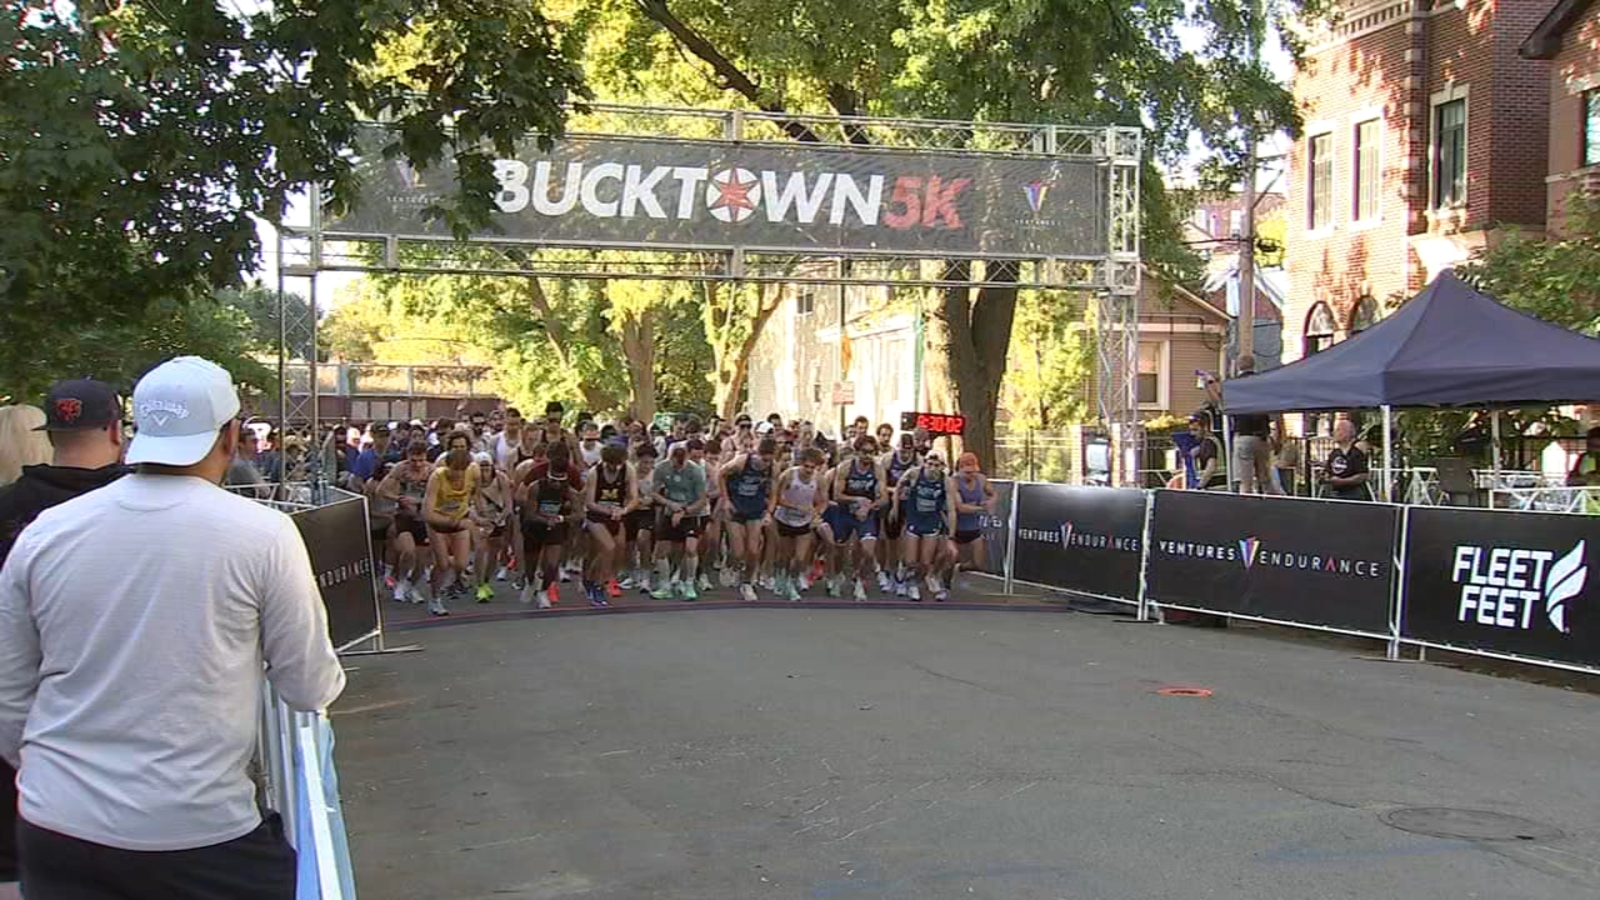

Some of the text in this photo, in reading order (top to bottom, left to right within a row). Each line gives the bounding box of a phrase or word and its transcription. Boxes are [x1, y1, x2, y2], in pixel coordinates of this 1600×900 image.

[883, 174, 973, 231] 5K
[1070, 531, 1140, 552] ENDURANCE
[1159, 540, 1381, 577] VENTURES ENDURANCE
[1452, 546, 1554, 590] FLEET
[1458, 584, 1542, 630] FEET
